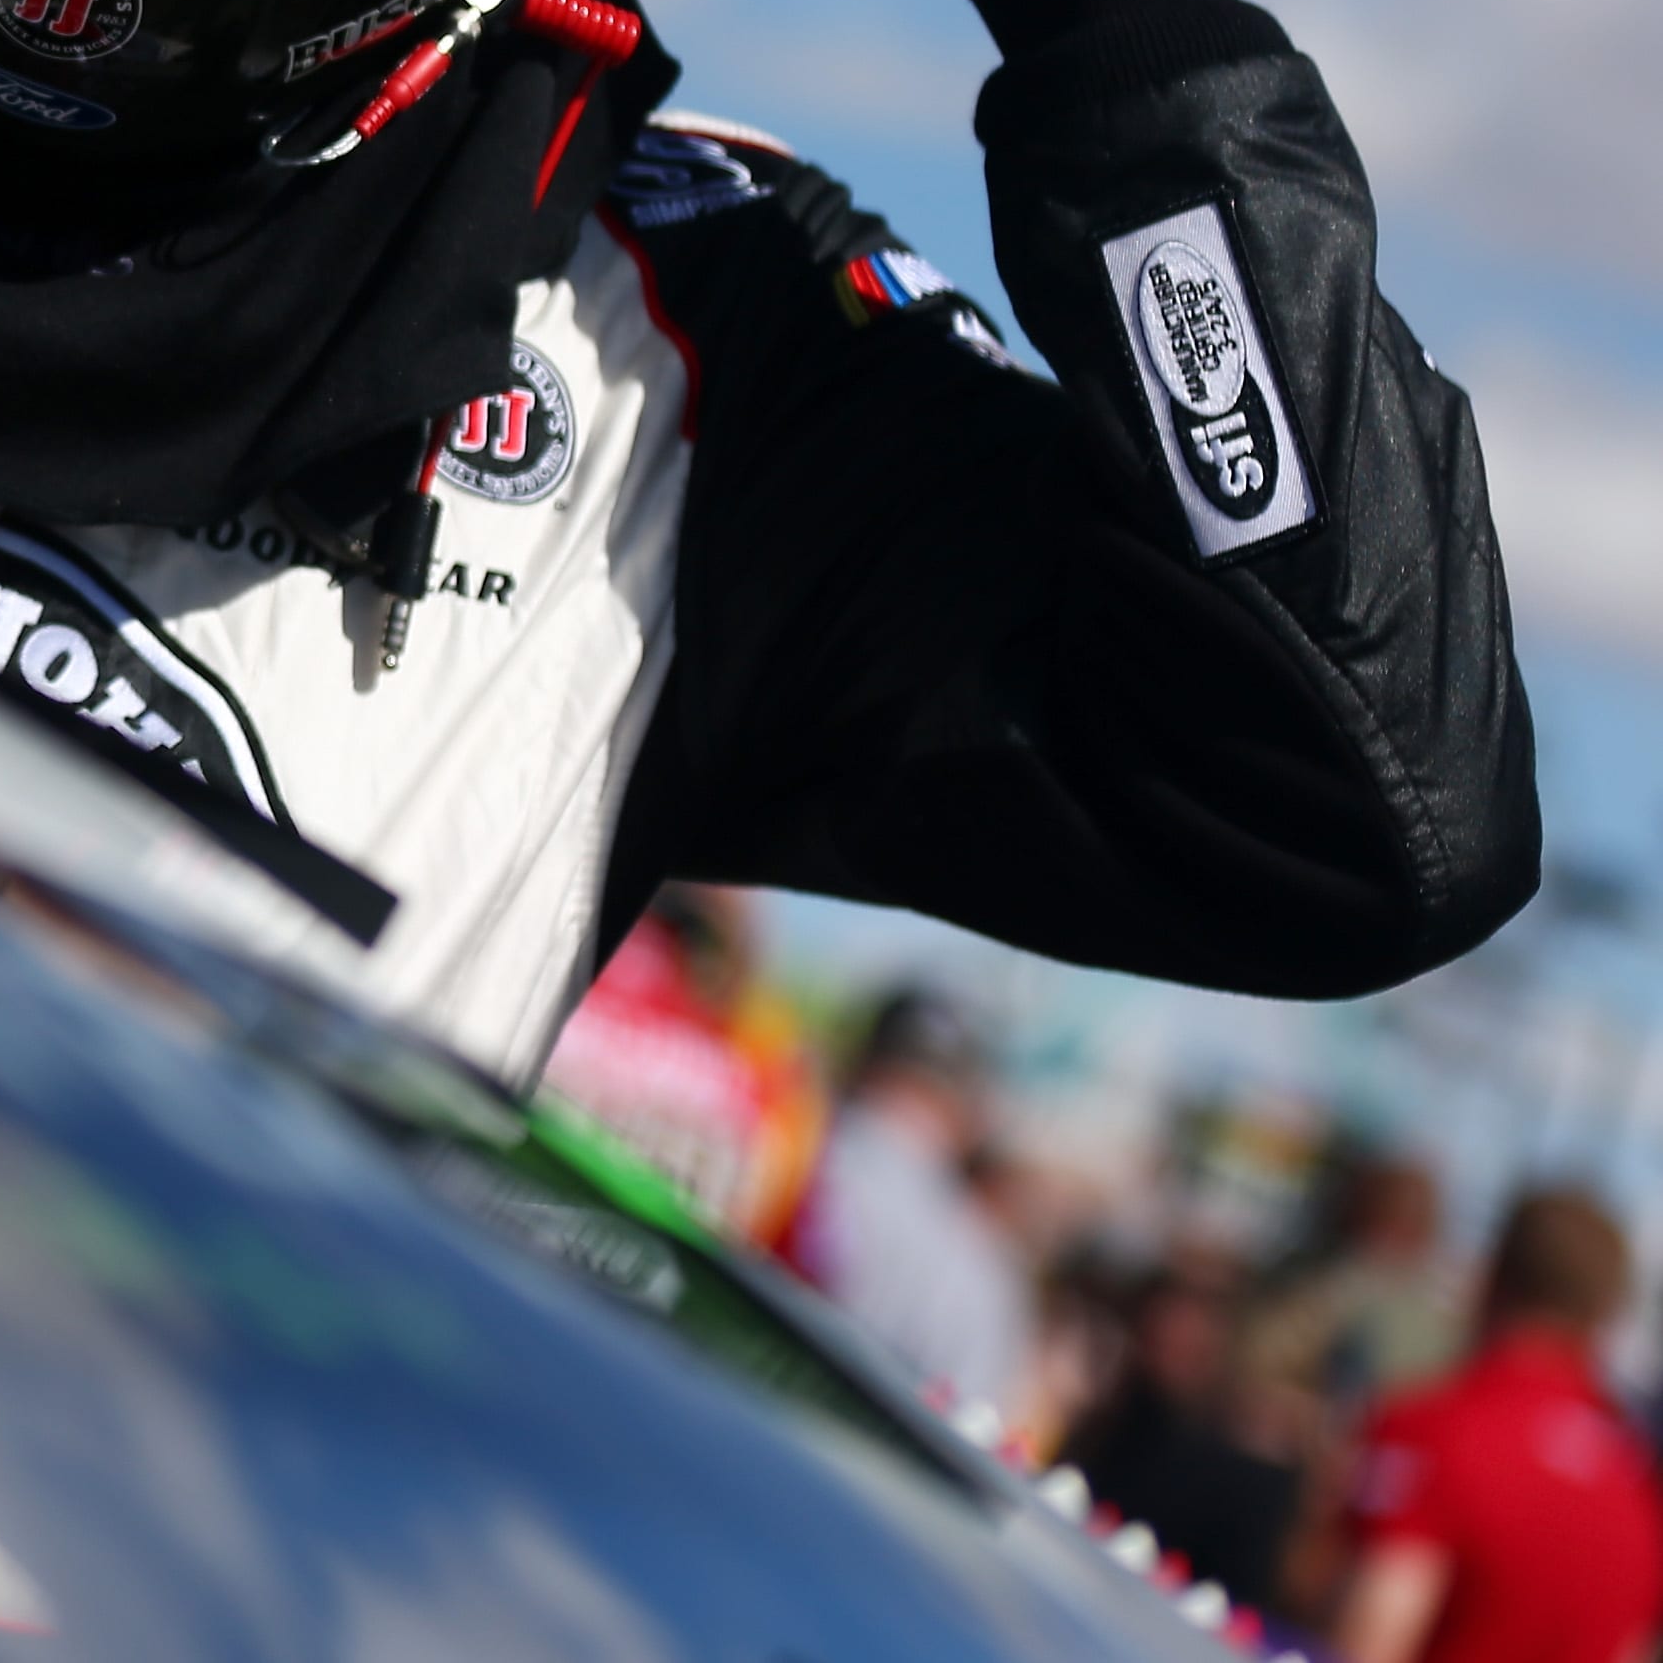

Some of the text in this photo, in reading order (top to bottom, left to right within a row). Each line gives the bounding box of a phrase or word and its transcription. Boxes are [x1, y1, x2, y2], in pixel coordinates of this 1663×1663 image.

[1148, 262, 1209, 404] MANUFACTURER
[1176, 278, 1222, 372] CERTIFIED
[511, 351, 567, 435] OHN'S
